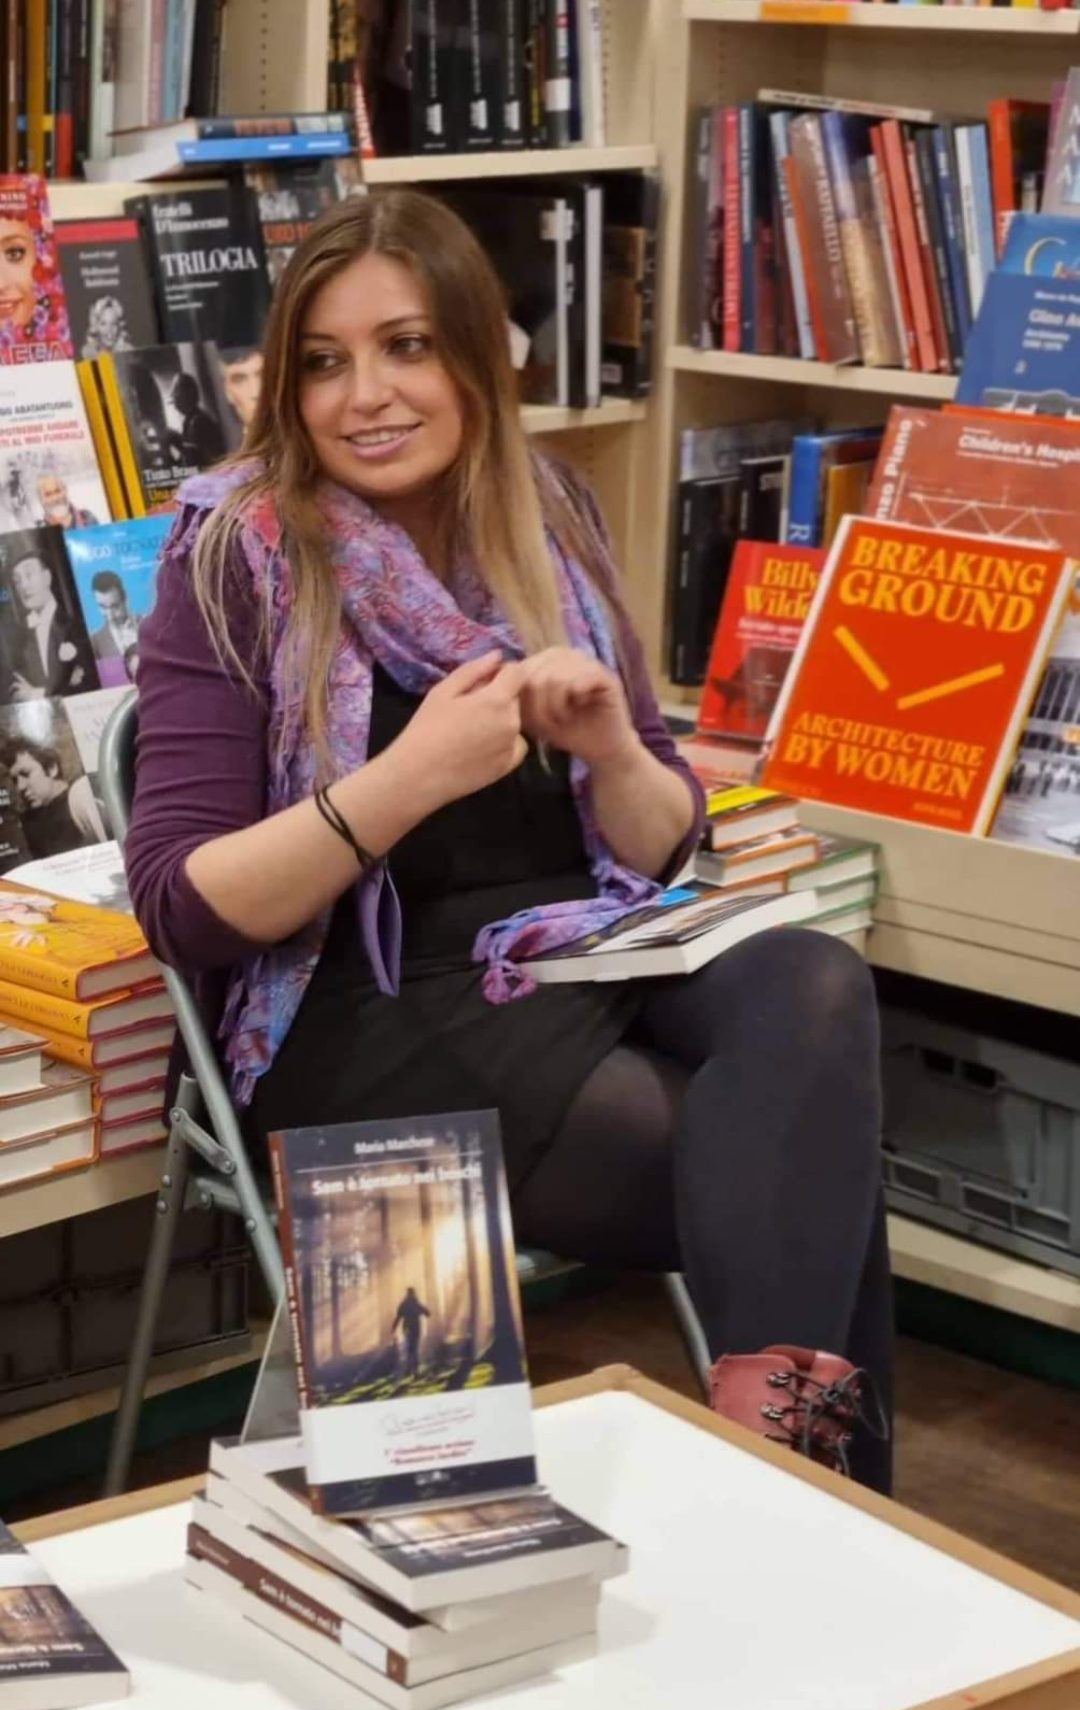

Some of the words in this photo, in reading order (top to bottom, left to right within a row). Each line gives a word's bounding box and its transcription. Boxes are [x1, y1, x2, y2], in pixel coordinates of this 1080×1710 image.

[160, 247, 258, 277] TRILOGIA
[884, 419, 913, 477] Piano
[959, 433, 1033, 457] Children's
[851, 536, 1047, 595] BREAKING
[839, 568, 1035, 633] GROUND
[783, 733, 832, 768] BY
[837, 742, 977, 800] WOMEN
[793, 711, 986, 767] ARCHITECTURE
[312, 1179, 344, 1196] Sam
